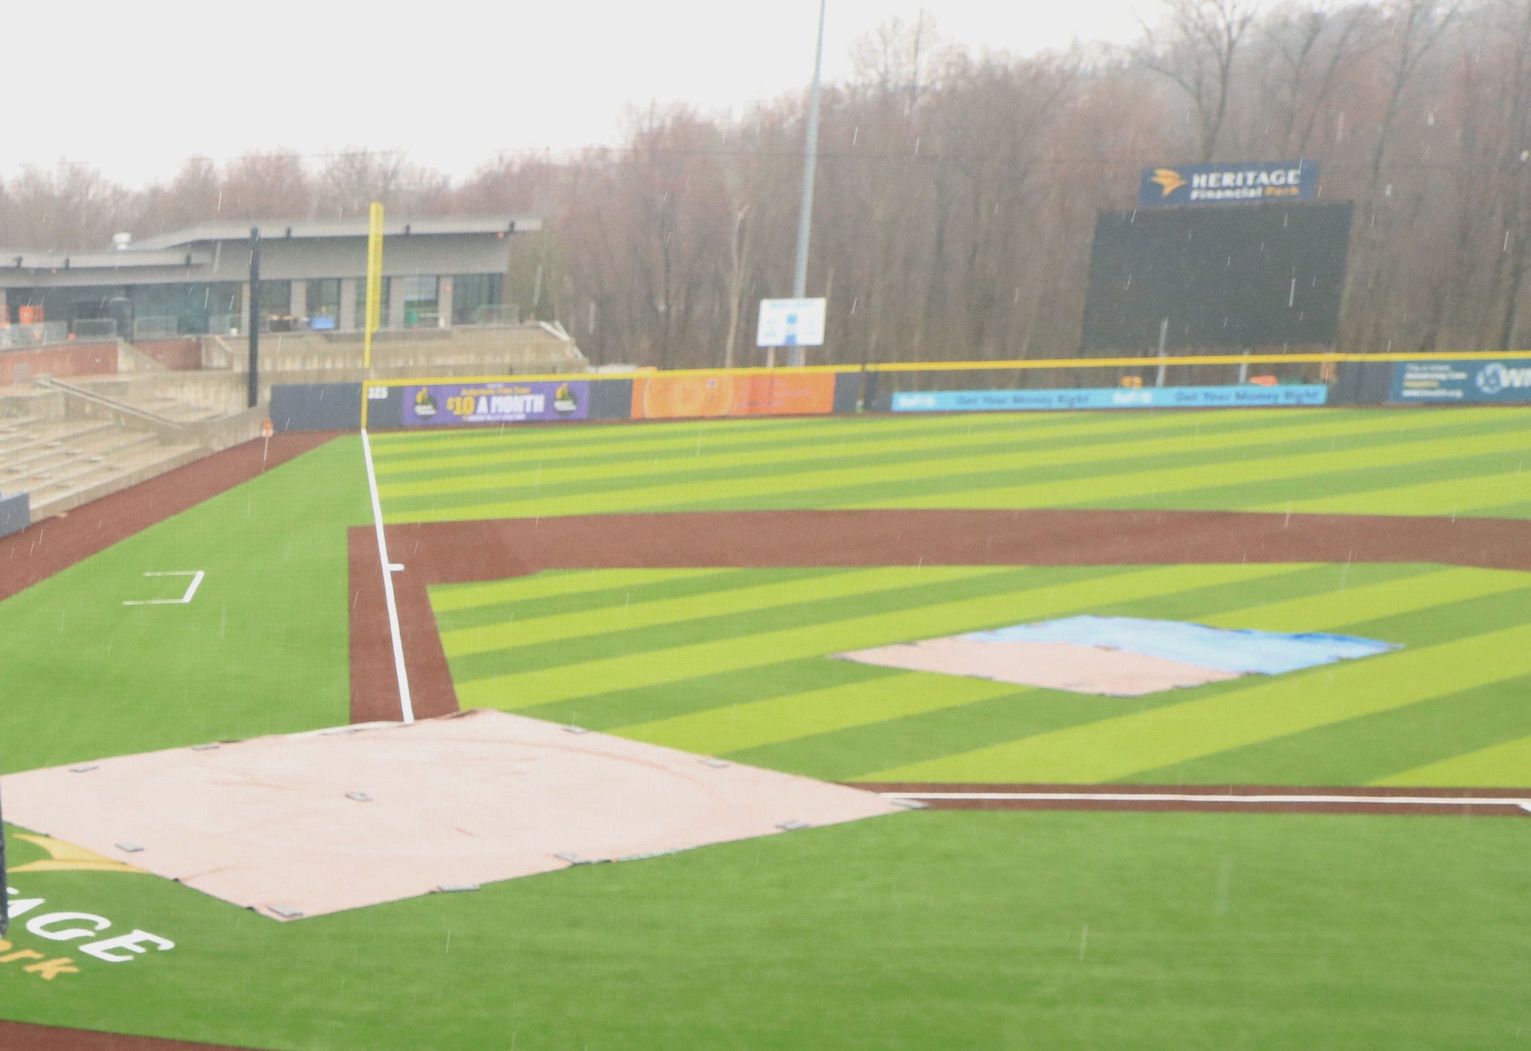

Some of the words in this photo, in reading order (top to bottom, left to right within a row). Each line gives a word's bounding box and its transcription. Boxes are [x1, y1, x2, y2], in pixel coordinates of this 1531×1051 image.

[1192, 169, 1300, 188] HERITAGE
[1190, 186, 1263, 200] Financial
[446, 396, 475, 416] $10
[476, 395, 489, 414] A
[490, 393, 545, 414] MONTH
